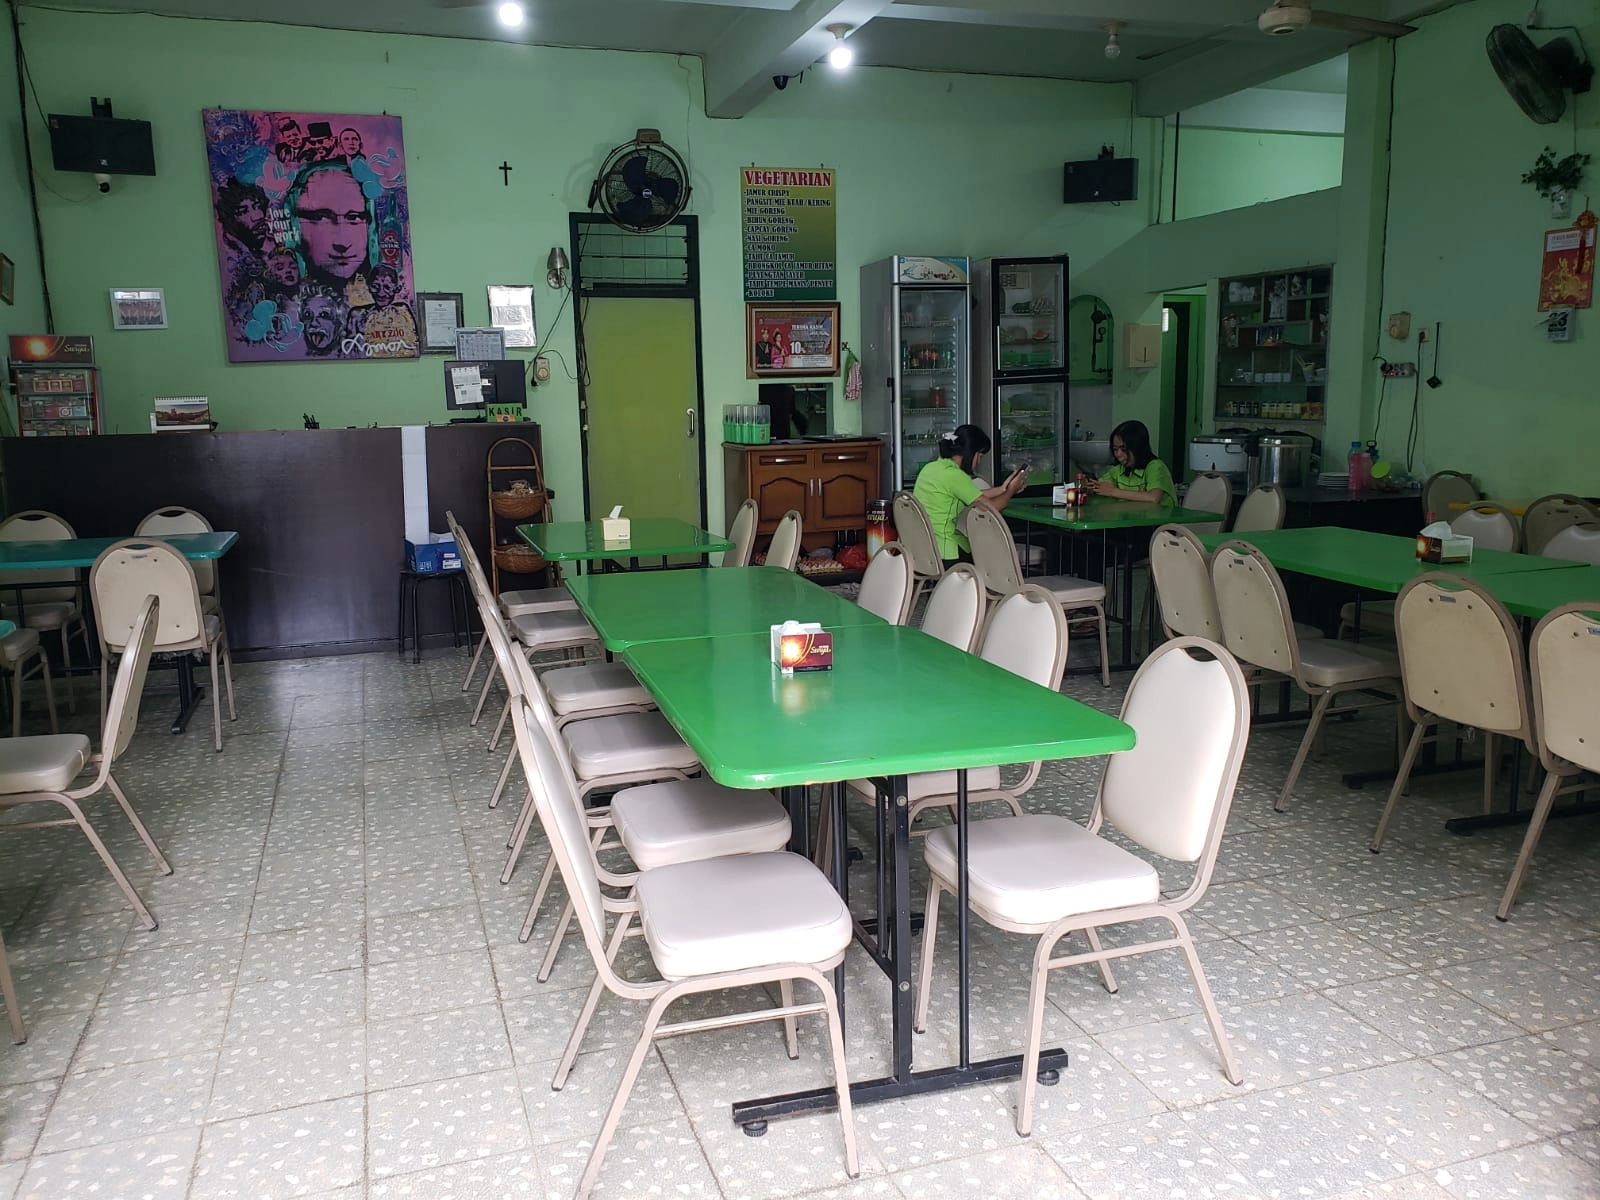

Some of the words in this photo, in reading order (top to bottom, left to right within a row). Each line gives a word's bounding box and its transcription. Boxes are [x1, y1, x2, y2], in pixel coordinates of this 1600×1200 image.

[744, 170, 831, 187] VEGETARIAN
[768, 189, 790, 197] CRISPY
[269, 207, 291, 220] love
[759, 207, 785, 215] GORENG
[266, 219, 291, 234] your
[772, 226, 798, 234] GORENG
[763, 234, 789, 242] GORENG
[775, 253, 795, 261] JAMUR
[488, 407, 523, 417] KASIR
[810, 646, 832, 656] Surya
